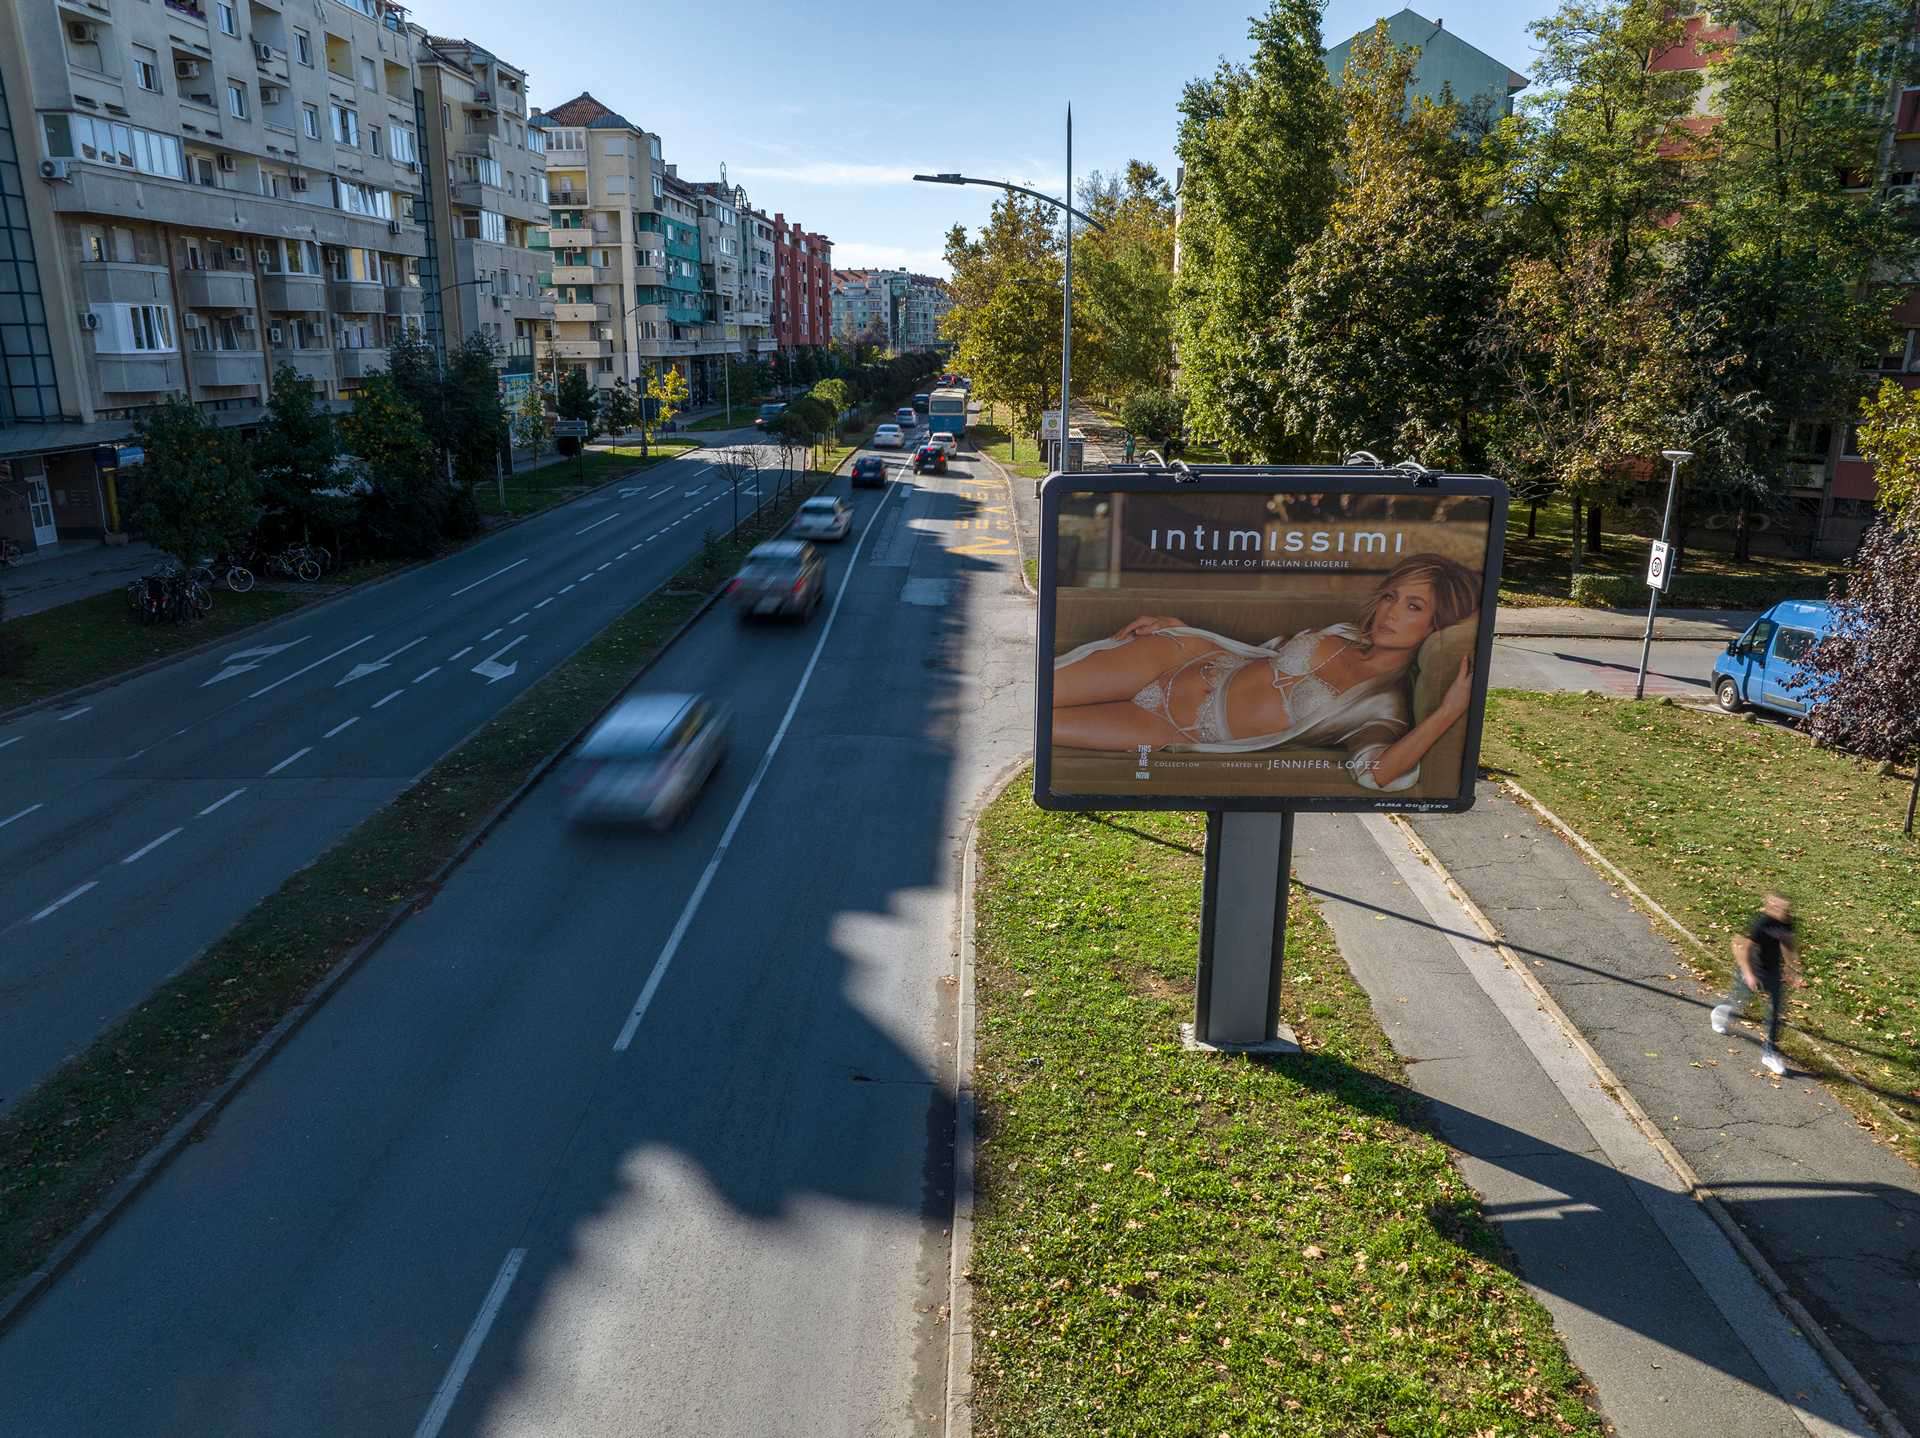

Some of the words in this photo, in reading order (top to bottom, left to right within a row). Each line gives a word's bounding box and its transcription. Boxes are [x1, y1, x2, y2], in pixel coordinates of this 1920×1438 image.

[1151, 525, 1403, 552] intimissimi
[1199, 559, 1217, 567] THE
[1221, 559, 1239, 567] ART
[1243, 559, 1257, 567] OF
[1261, 559, 1301, 568] ITALIAN
[1304, 560, 1350, 568] LINGERIE
[1154, 760, 1200, 768] COLLECTION
[1267, 759, 1330, 770] JENNIFER
[1337, 760, 1382, 770] LOPEZ
